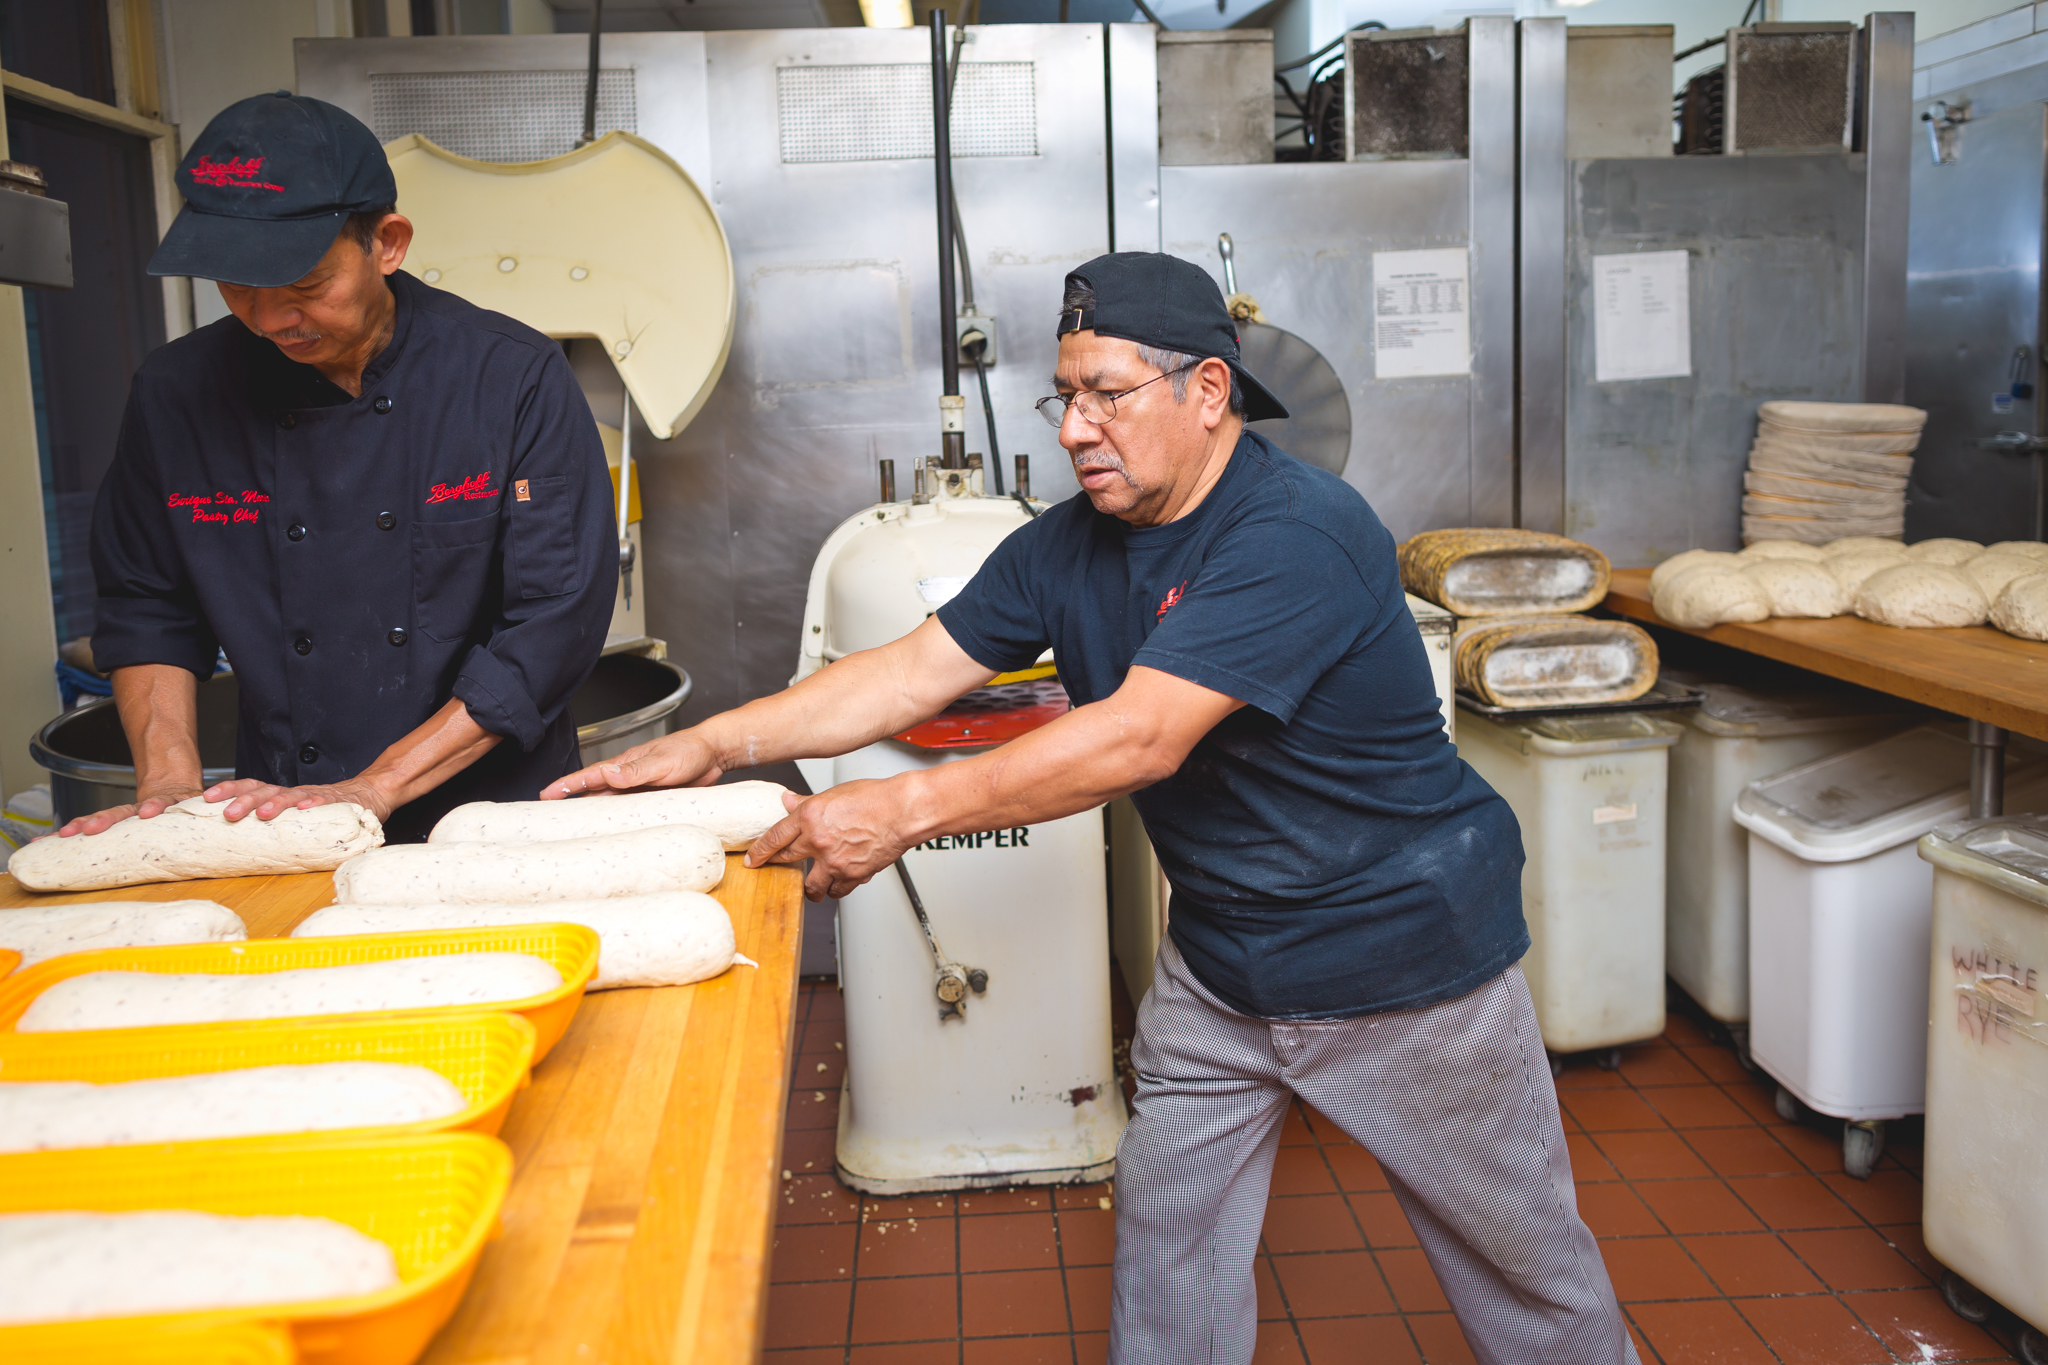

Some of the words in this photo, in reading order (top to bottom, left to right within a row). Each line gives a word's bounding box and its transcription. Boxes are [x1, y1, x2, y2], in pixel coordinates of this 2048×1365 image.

[168, 493, 212, 509] Enrique
[426, 472, 490, 503] Berghoff
[192, 509, 229, 525] Pastry
[233, 508, 259, 523] Chef
[1951, 945, 2038, 992] WHITE
[1958, 994, 2012, 1046] RYE
